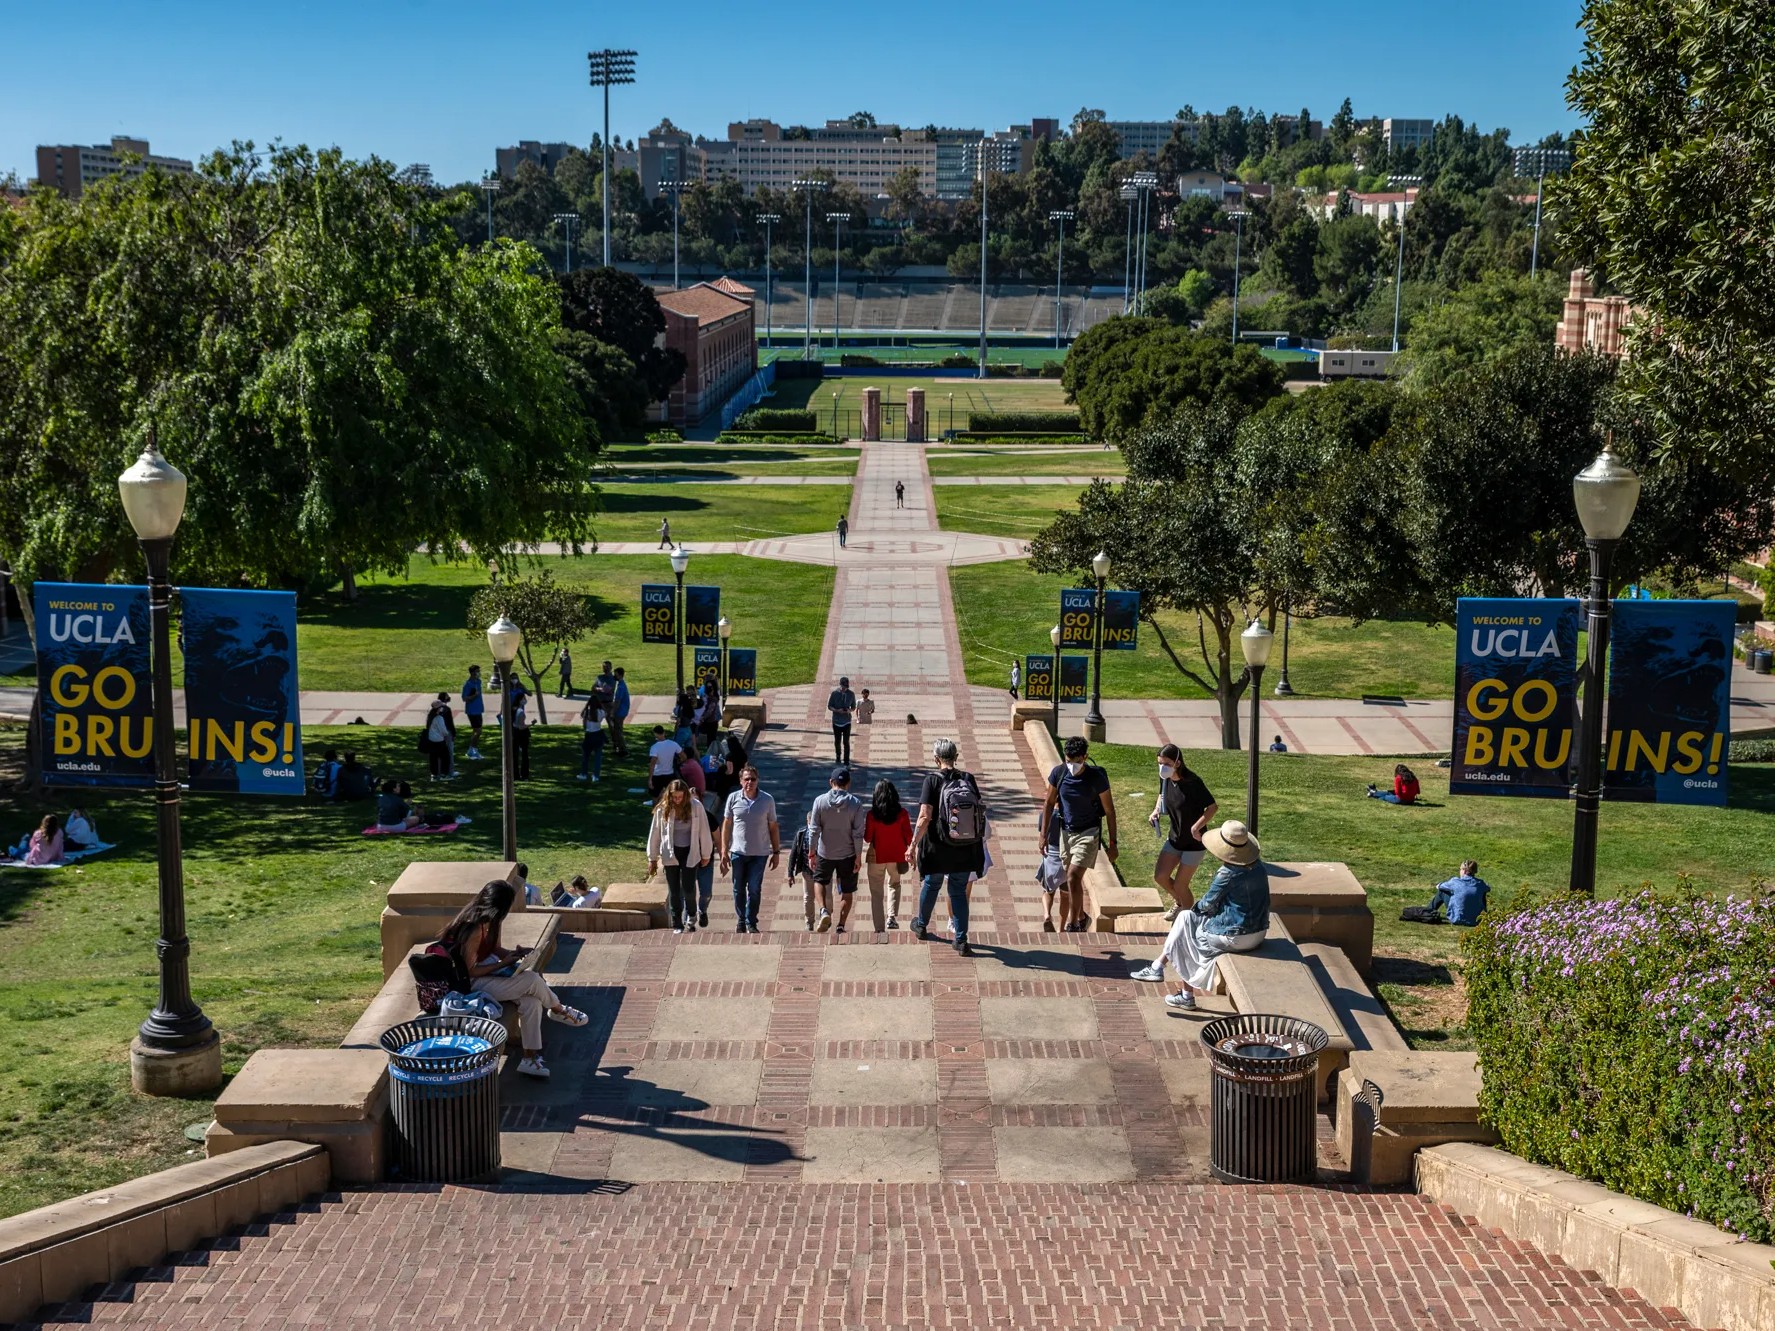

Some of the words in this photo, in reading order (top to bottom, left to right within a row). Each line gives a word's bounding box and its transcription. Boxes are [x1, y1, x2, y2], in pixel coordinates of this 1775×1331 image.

[646, 594, 671, 602] UCLA
[1064, 598, 1091, 607] UCLA
[49, 601, 98, 611] WELCOME
[101, 603, 115, 611] TO
[645, 608, 670, 622] GO
[1064, 612, 1090, 626] GO
[1472, 616, 1525, 626] WELCOME
[1528, 616, 1542, 626] TO
[50, 613, 136, 645] UCLA
[645, 622, 674, 636] BRU
[686, 623, 717, 638] INS!
[1062, 627, 1094, 641] BRU
[1103, 628, 1136, 642] INS!
[1471, 628, 1561, 658] UCLA
[696, 666, 718, 677] GO
[1028, 673, 1049, 684] GO
[50, 664, 136, 710] GO
[1028, 685, 1053, 696] BRU
[1060, 685, 1086, 697] INS!
[1466, 678, 1557, 723] GO
[54, 713, 154, 759] BRU
[190, 718, 294, 764] INS!
[1464, 726, 1573, 770] BRU
[1606, 729, 1724, 776] INS!
[57, 761, 101, 772] ucla.edu
[262, 767, 295, 778] @ucla
[1465, 771, 1511, 782] ucla.edu
[1683, 778, 1718, 789] @ucla
[448, 1072, 474, 1081] RECYCLE
[1280, 1072, 1303, 1081] LANDFILL
